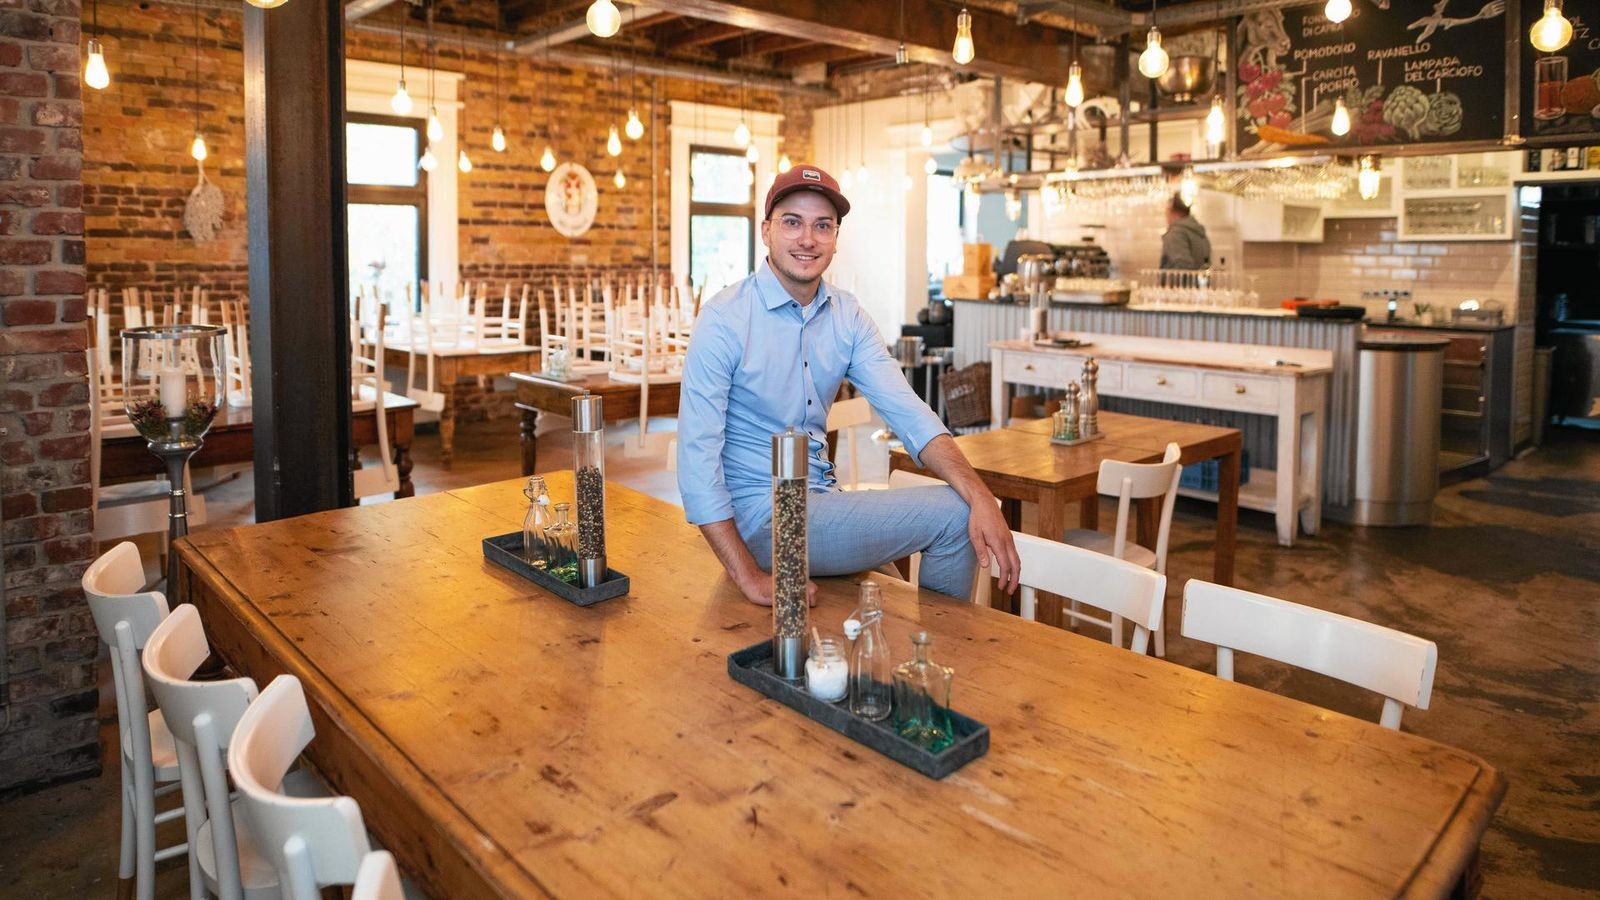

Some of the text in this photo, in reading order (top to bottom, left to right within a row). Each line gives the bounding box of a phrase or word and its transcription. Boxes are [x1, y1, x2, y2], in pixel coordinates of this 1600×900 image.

[1294, 42, 1356, 60] POMODORO
[1368, 42, 1431, 60] RAVANELLO
[1404, 56, 1460, 71] LAMPADA
[1313, 66, 1357, 81] CAROTA
[1404, 65, 1483, 82] DEL CARCIOFO
[1319, 77, 1359, 93] PORRO
